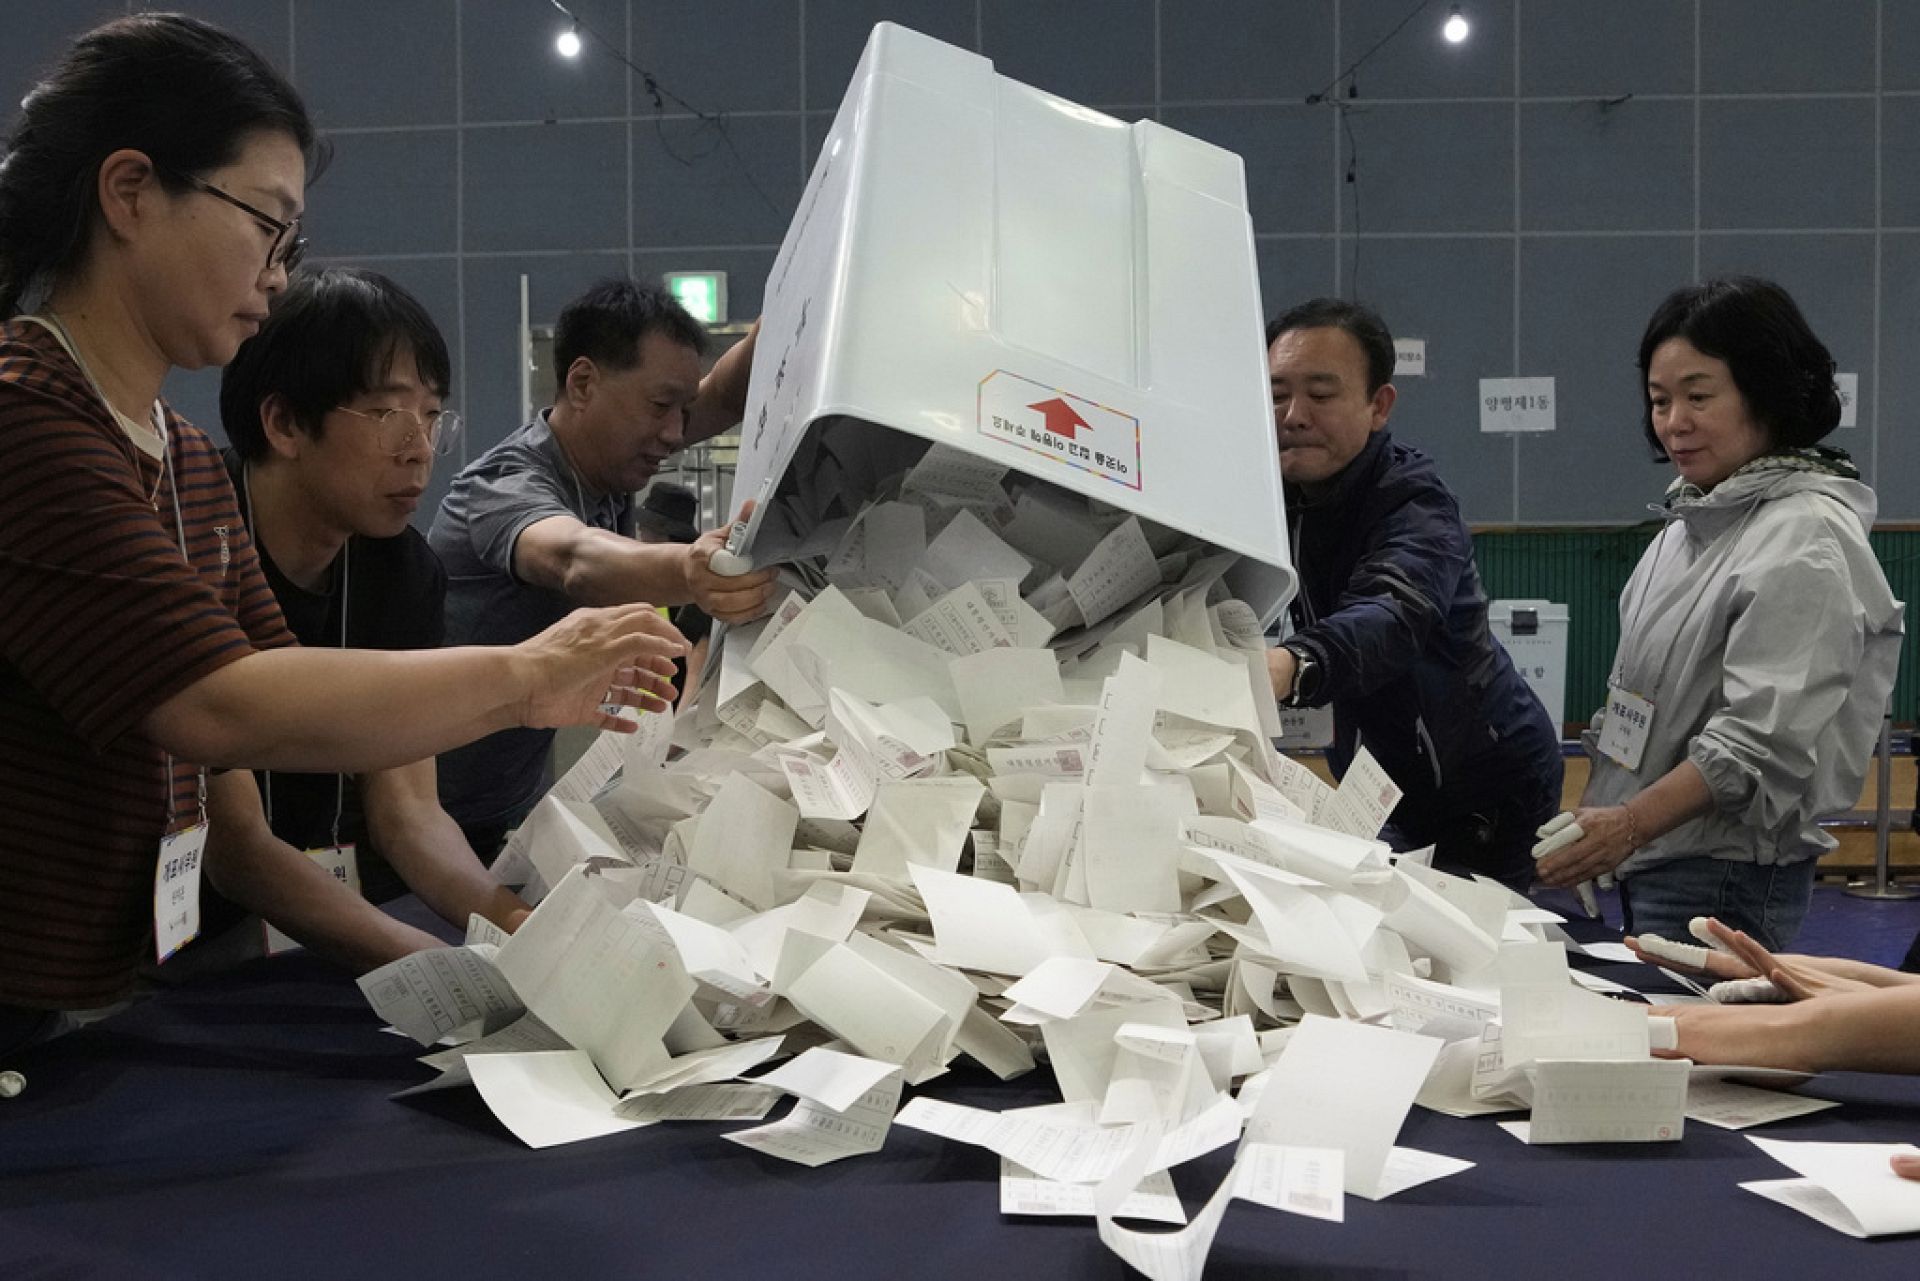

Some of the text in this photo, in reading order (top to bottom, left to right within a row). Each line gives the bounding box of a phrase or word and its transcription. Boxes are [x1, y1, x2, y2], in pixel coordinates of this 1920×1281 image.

[1484, 395, 1550, 412] 양평제1동
[992, 415, 1026, 437] 주세요
[1068, 442, 1090, 461] 잡고
[1095, 452, 1127, 474] 이곳을
[1612, 701, 1647, 729] 개표사무원
